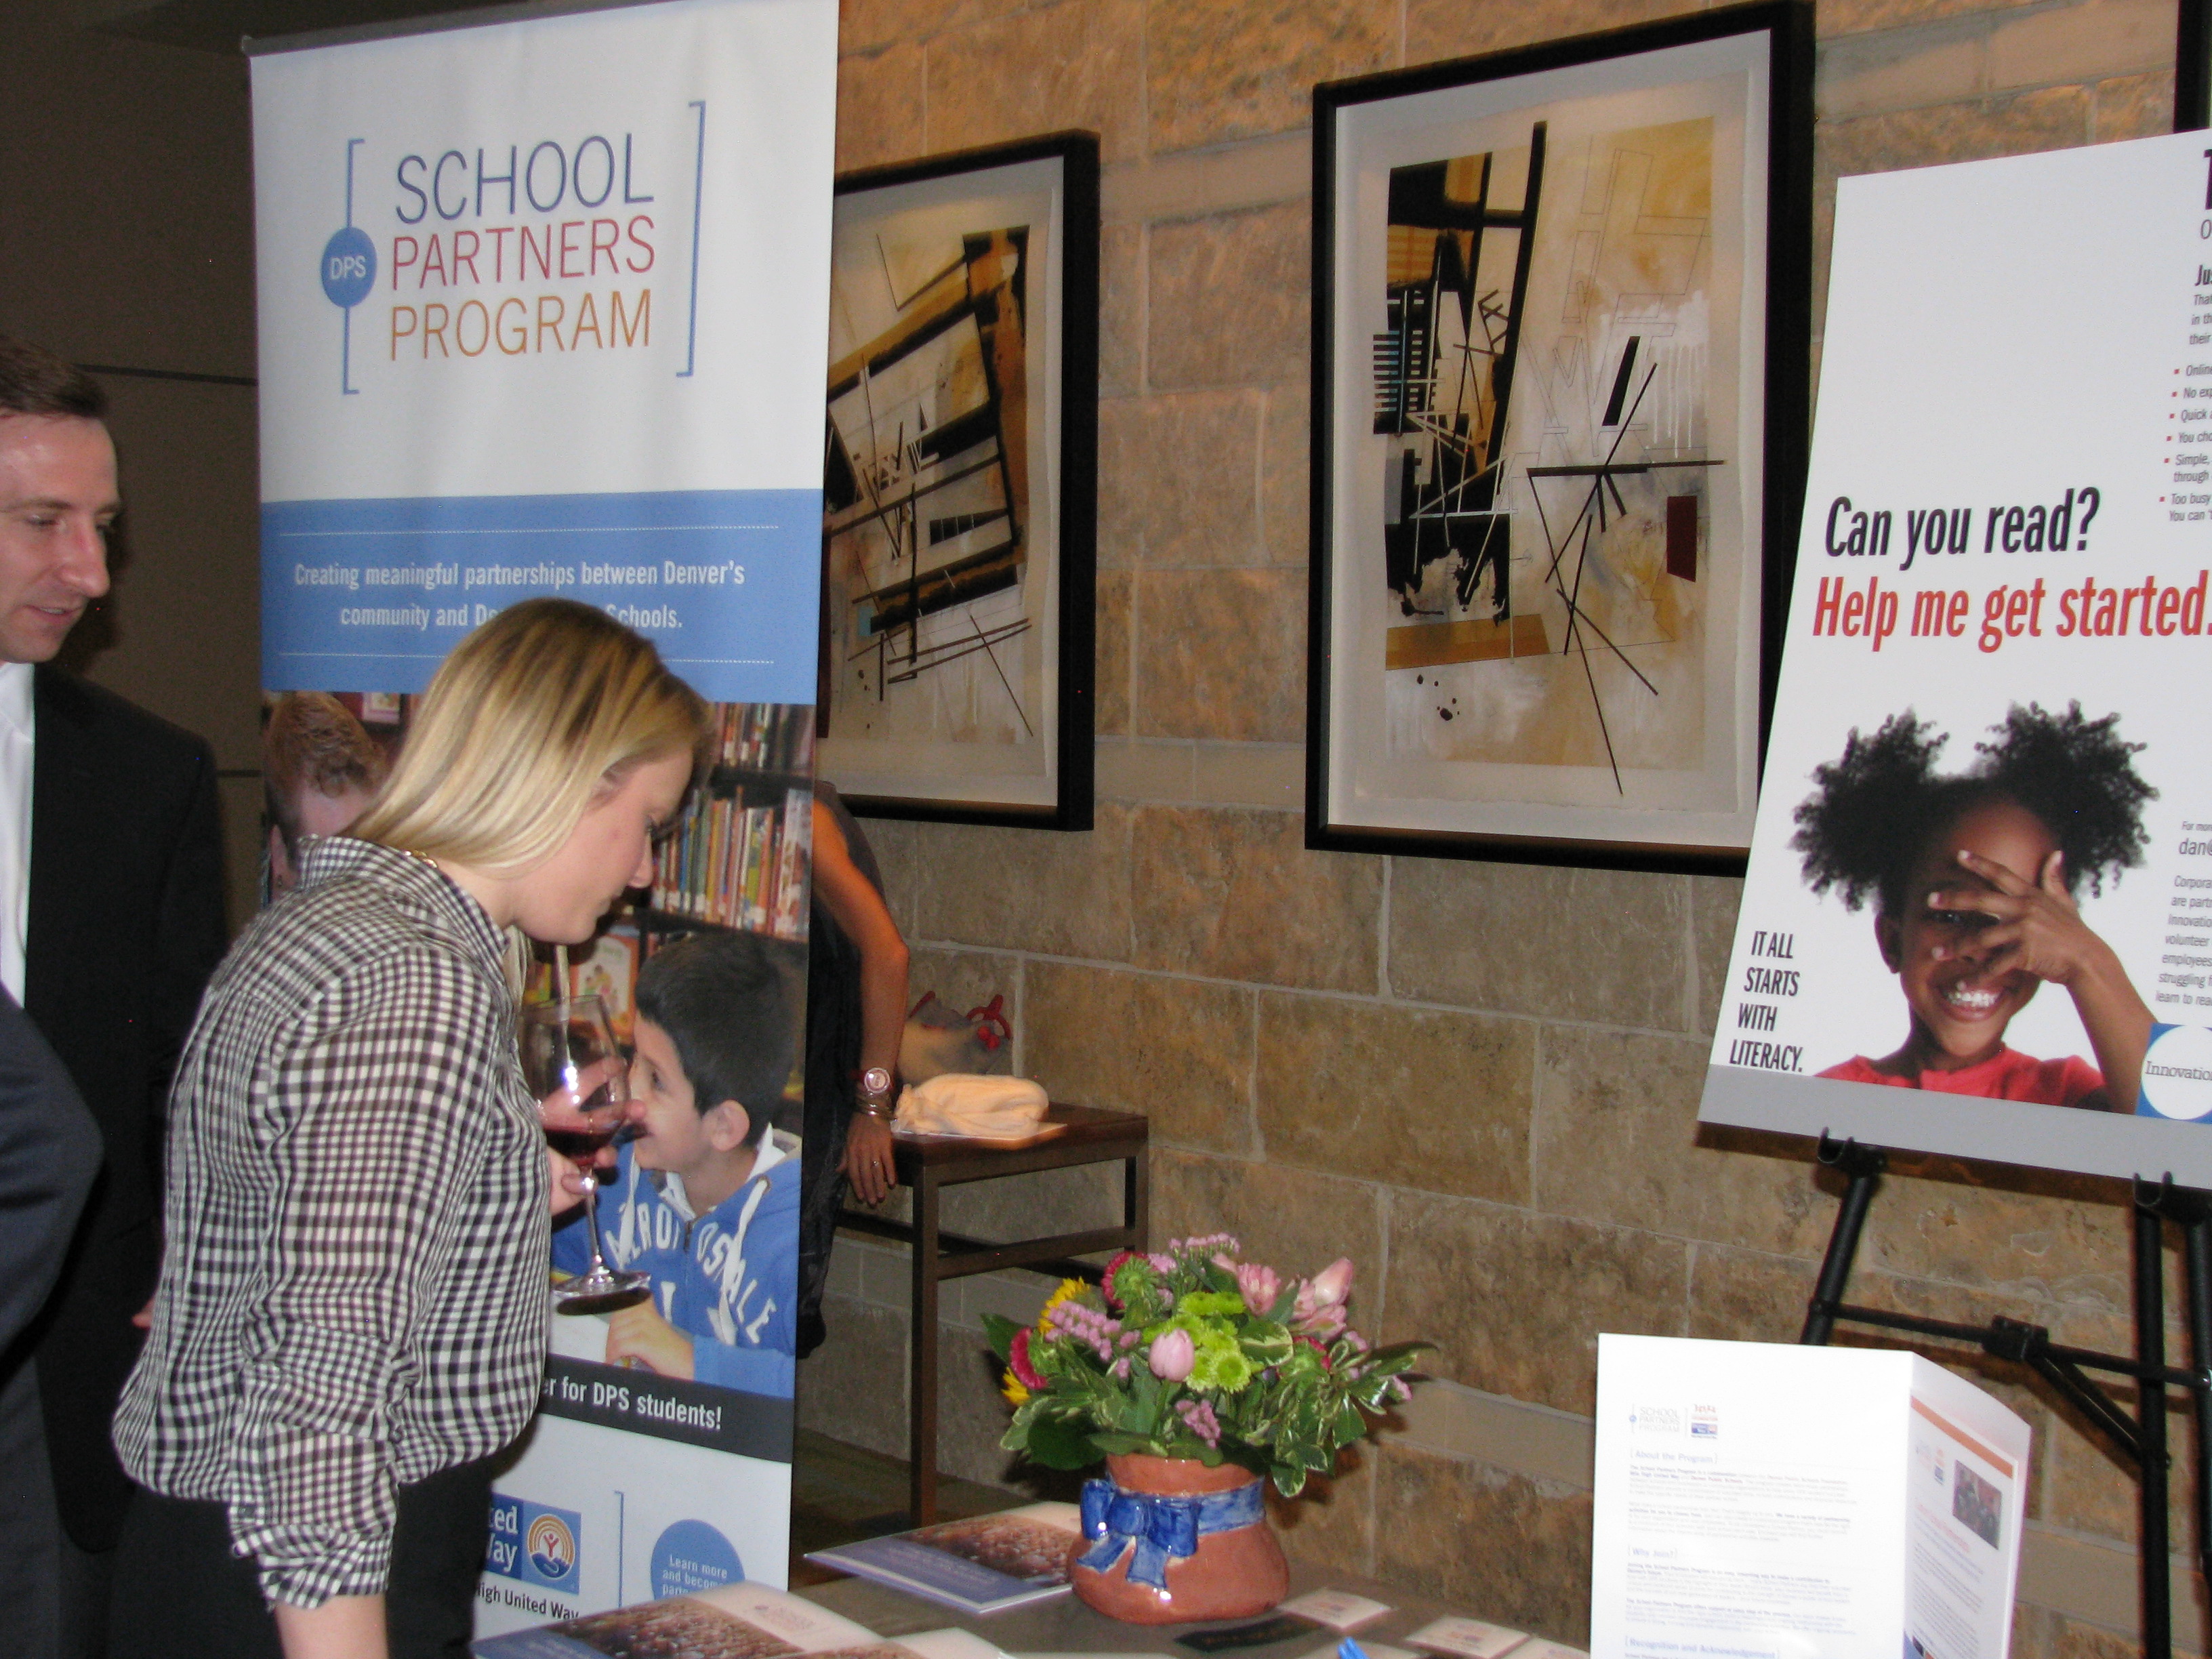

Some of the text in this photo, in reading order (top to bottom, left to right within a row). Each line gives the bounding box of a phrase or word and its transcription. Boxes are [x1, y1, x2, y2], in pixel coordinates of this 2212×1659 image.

[395, 134, 655, 224] SCHOOL
[331, 255, 366, 279] DPS
[392, 214, 657, 291] PARTNERS
[390, 288, 651, 361] PROGRAM
[2184, 387, 2196, 398] No
[2181, 409, 2207, 423] Quick
[2171, 493, 2211, 506] Too busy
[1824, 487, 2101, 571] Can you read?
[294, 559, 745, 590] Creating meaningful partnerships between Denver's
[341, 602, 430, 632] community
[436, 604, 468, 626] and
[1813, 575, 1898, 653] Help
[1910, 588, 1969, 638] me
[1978, 577, 2046, 653] get
[1751, 930, 1794, 959] IT ALL
[1744, 967, 1801, 996] STARTS
[1738, 1002, 1778, 1031] WITH
[1729, 1039, 1803, 1073] LITERACY.
[561, 1376, 588, 1401] for
[593, 1381, 630, 1411] DPS
[637, 1393, 722, 1430] students!
[1639, 1406, 1679, 1418] SCHOOL
[663, 1570, 681, 1582] and
[669, 1554, 727, 1578] Learn more
[505, 1589, 546, 1615] United
